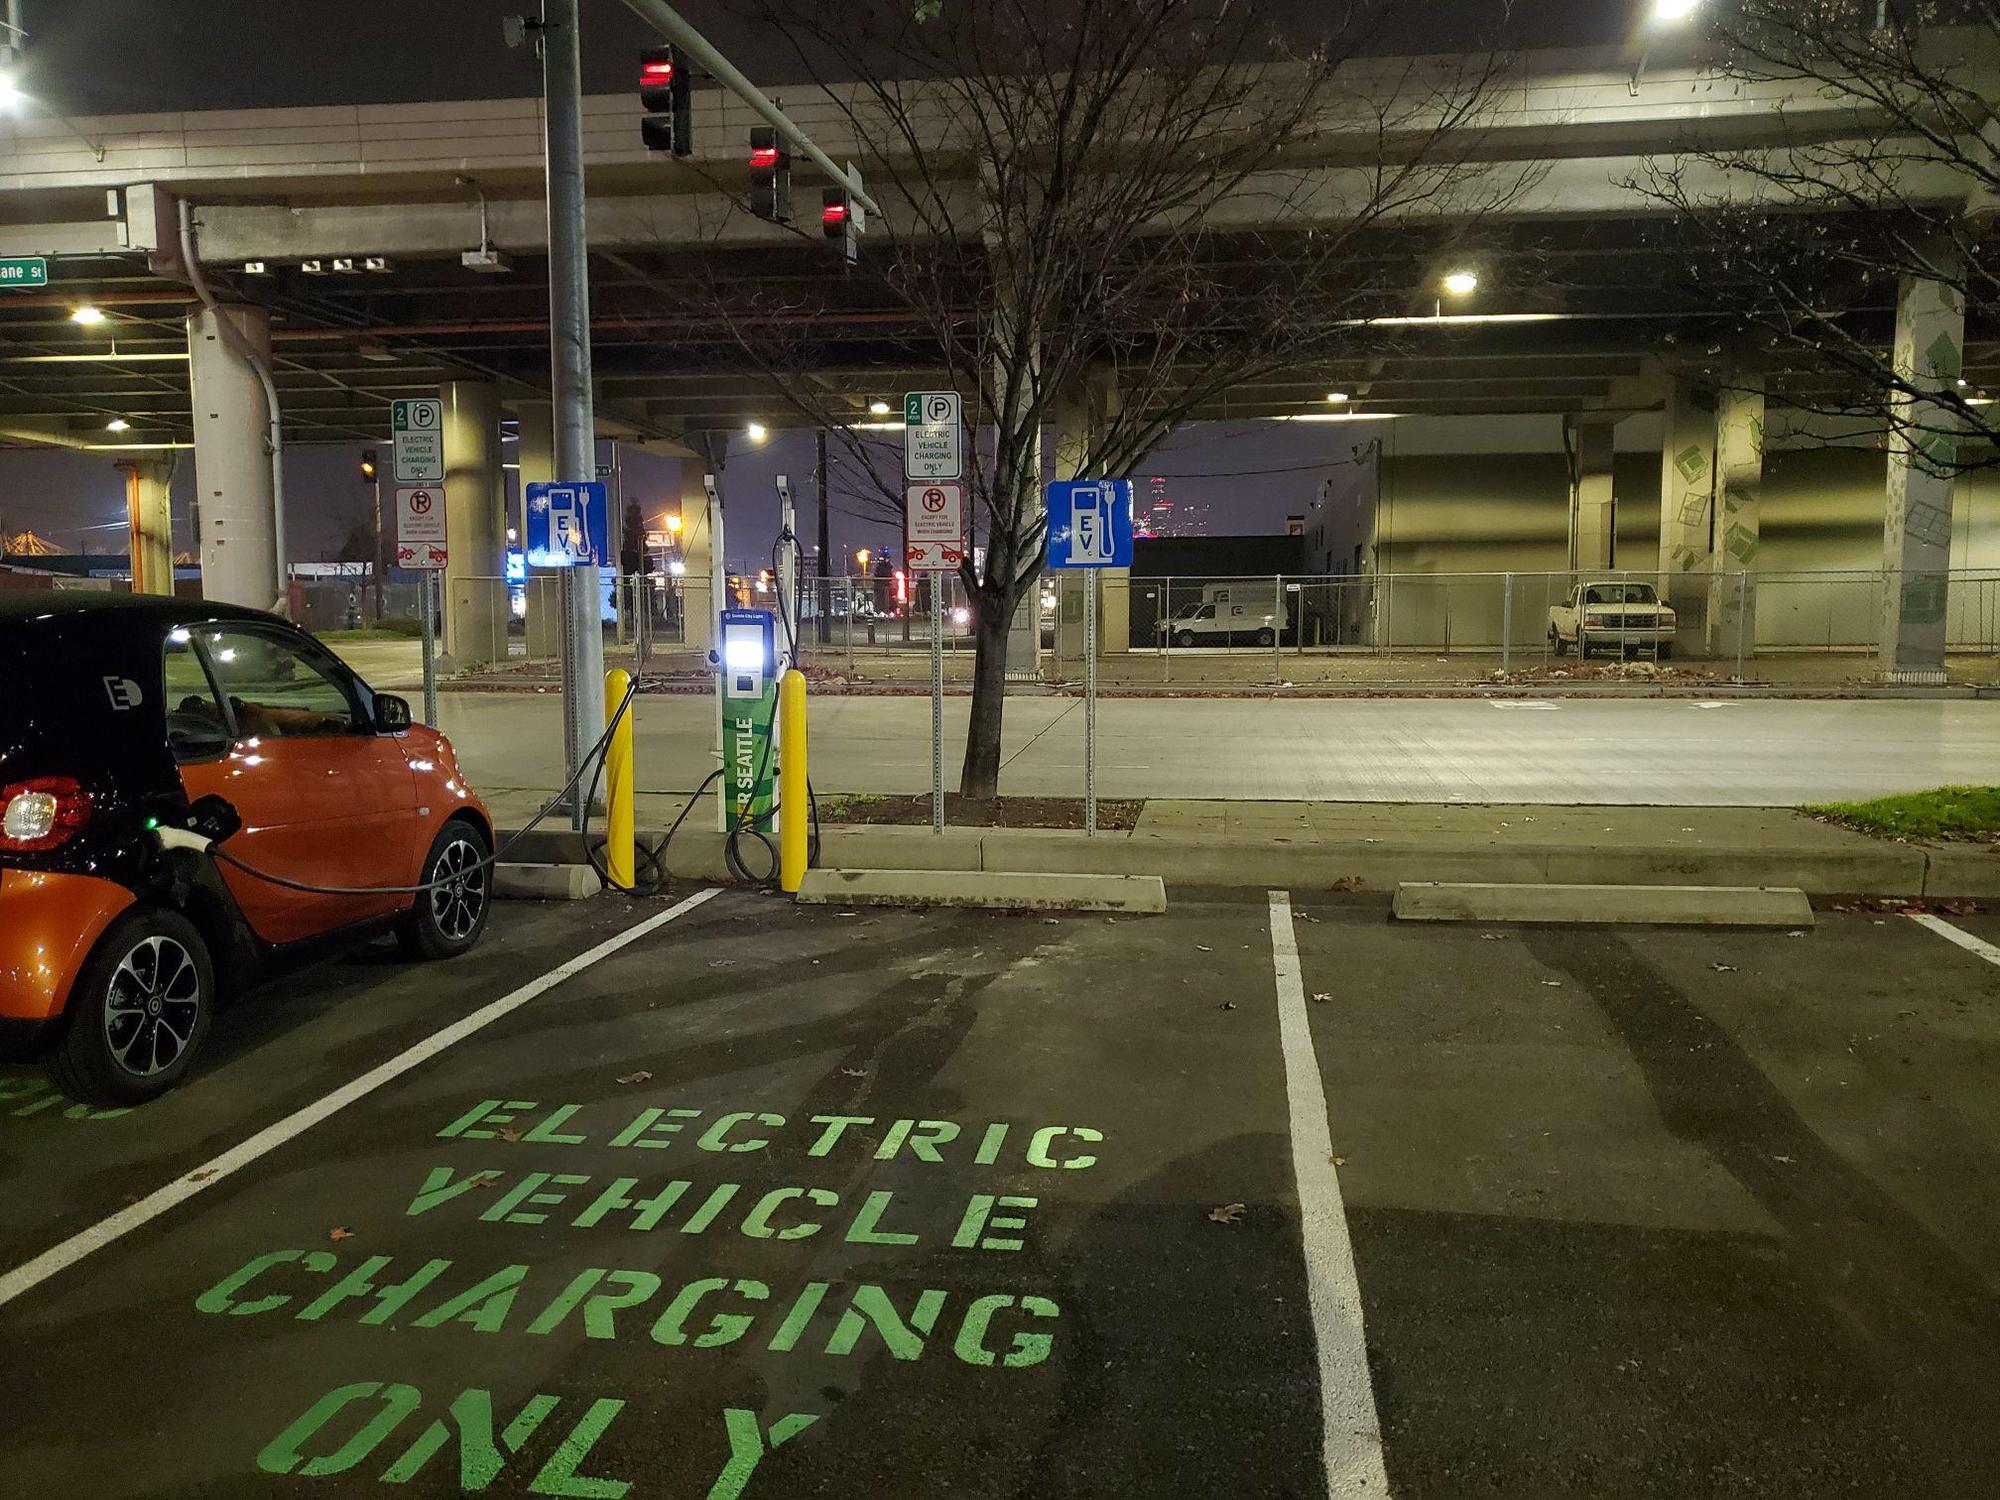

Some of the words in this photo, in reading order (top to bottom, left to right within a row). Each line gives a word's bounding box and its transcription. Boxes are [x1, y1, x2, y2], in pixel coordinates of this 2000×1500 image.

[0, 266, 24, 279] ane
[396, 407, 405, 421] 2
[910, 401, 918, 415] 2
[402, 435, 434, 444] ELECTRIC
[915, 430, 950, 439] ELECTRIC
[404, 446, 433, 454] VEHICLE
[918, 441, 948, 449] VEHICLE
[401, 456, 436, 464] CHARGING
[914, 452, 952, 460] CHARGING
[410, 466, 428, 474] ONLY
[923, 463, 943, 471] ONLY
[1079, 515, 1093, 550] EV
[735, 717, 754, 789] SEATTLE
[434, 1099, 1104, 1170] ELECTRIC
[405, 1166, 1039, 1251] VEHICLE
[195, 1250, 1061, 1368] CHARGING
[256, 1382, 820, 1500] ONLY
